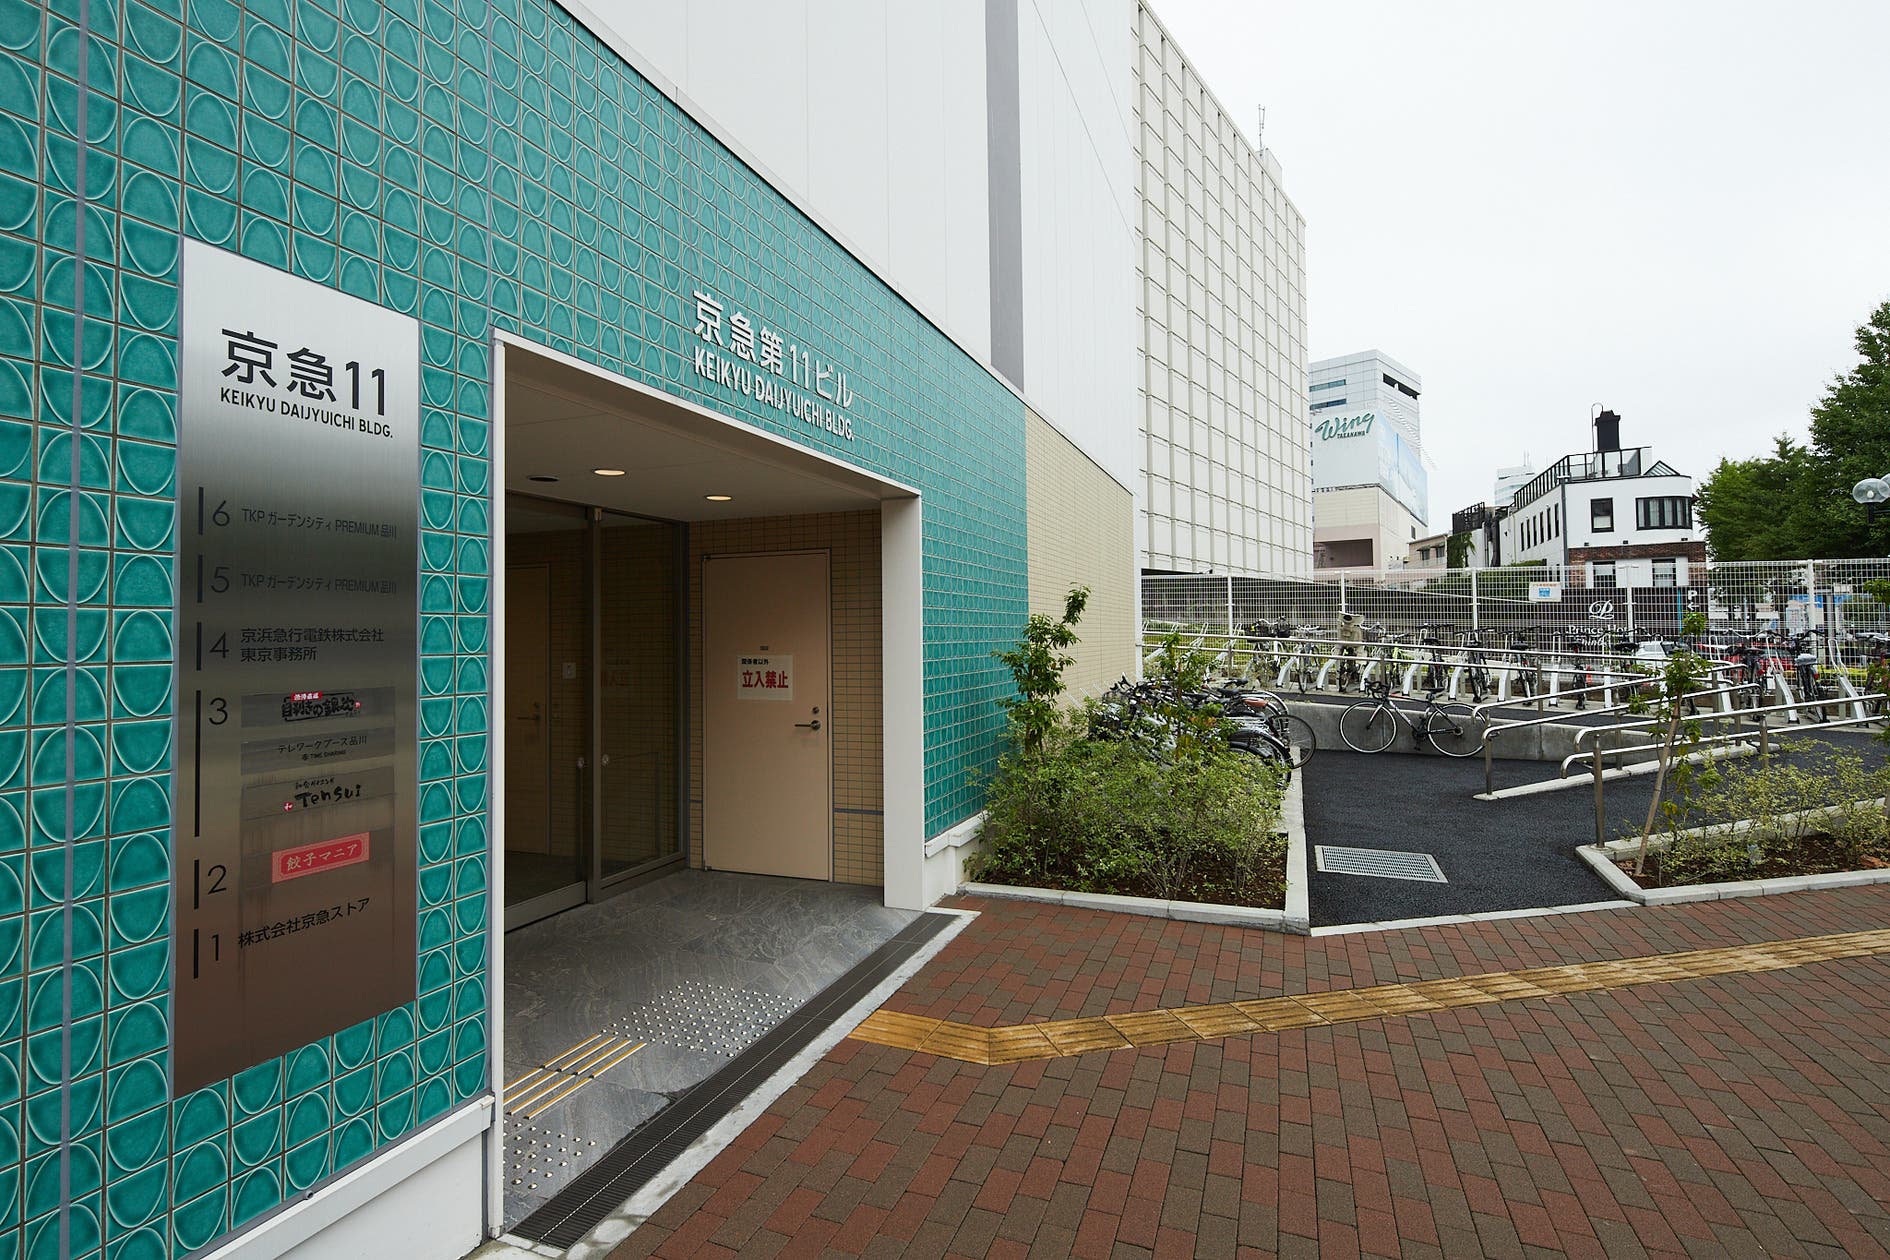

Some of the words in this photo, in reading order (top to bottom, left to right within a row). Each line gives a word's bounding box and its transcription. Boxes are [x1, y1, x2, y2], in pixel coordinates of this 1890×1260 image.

[693, 290, 853, 409] 京急第11ビル
[221, 328, 385, 416] 京急11
[694, 345, 751, 396] KEIKYU
[755, 374, 823, 428] DAIJYUICHI
[825, 407, 855, 441] BLDG.
[220, 387, 276, 413] KEIKYU
[281, 400, 355, 430] DAIJYUICHI
[359, 418, 393, 438] BLDG.
[1315, 412, 1375, 441] Wing
[212, 500, 230, 527] 6
[211, 566, 230, 593] 5
[1688, 590, 1698, 600] P
[209, 632, 229, 659] 4
[240, 627, 384, 643] 京浜急行電鉄株式会社
[240, 647, 317, 662] 東京事務所
[742, 670, 788, 688] 立入禁止
[208, 697, 228, 725] 3
[278, 735, 367, 753] テレワークブース品川
[294, 784, 362, 808] Tensui
[286, 843, 357, 872] 餃子マニア
[207, 864, 227, 895] 2
[237, 897, 370, 950] 株式会社京急ストア
[211, 933, 219, 962] 1
